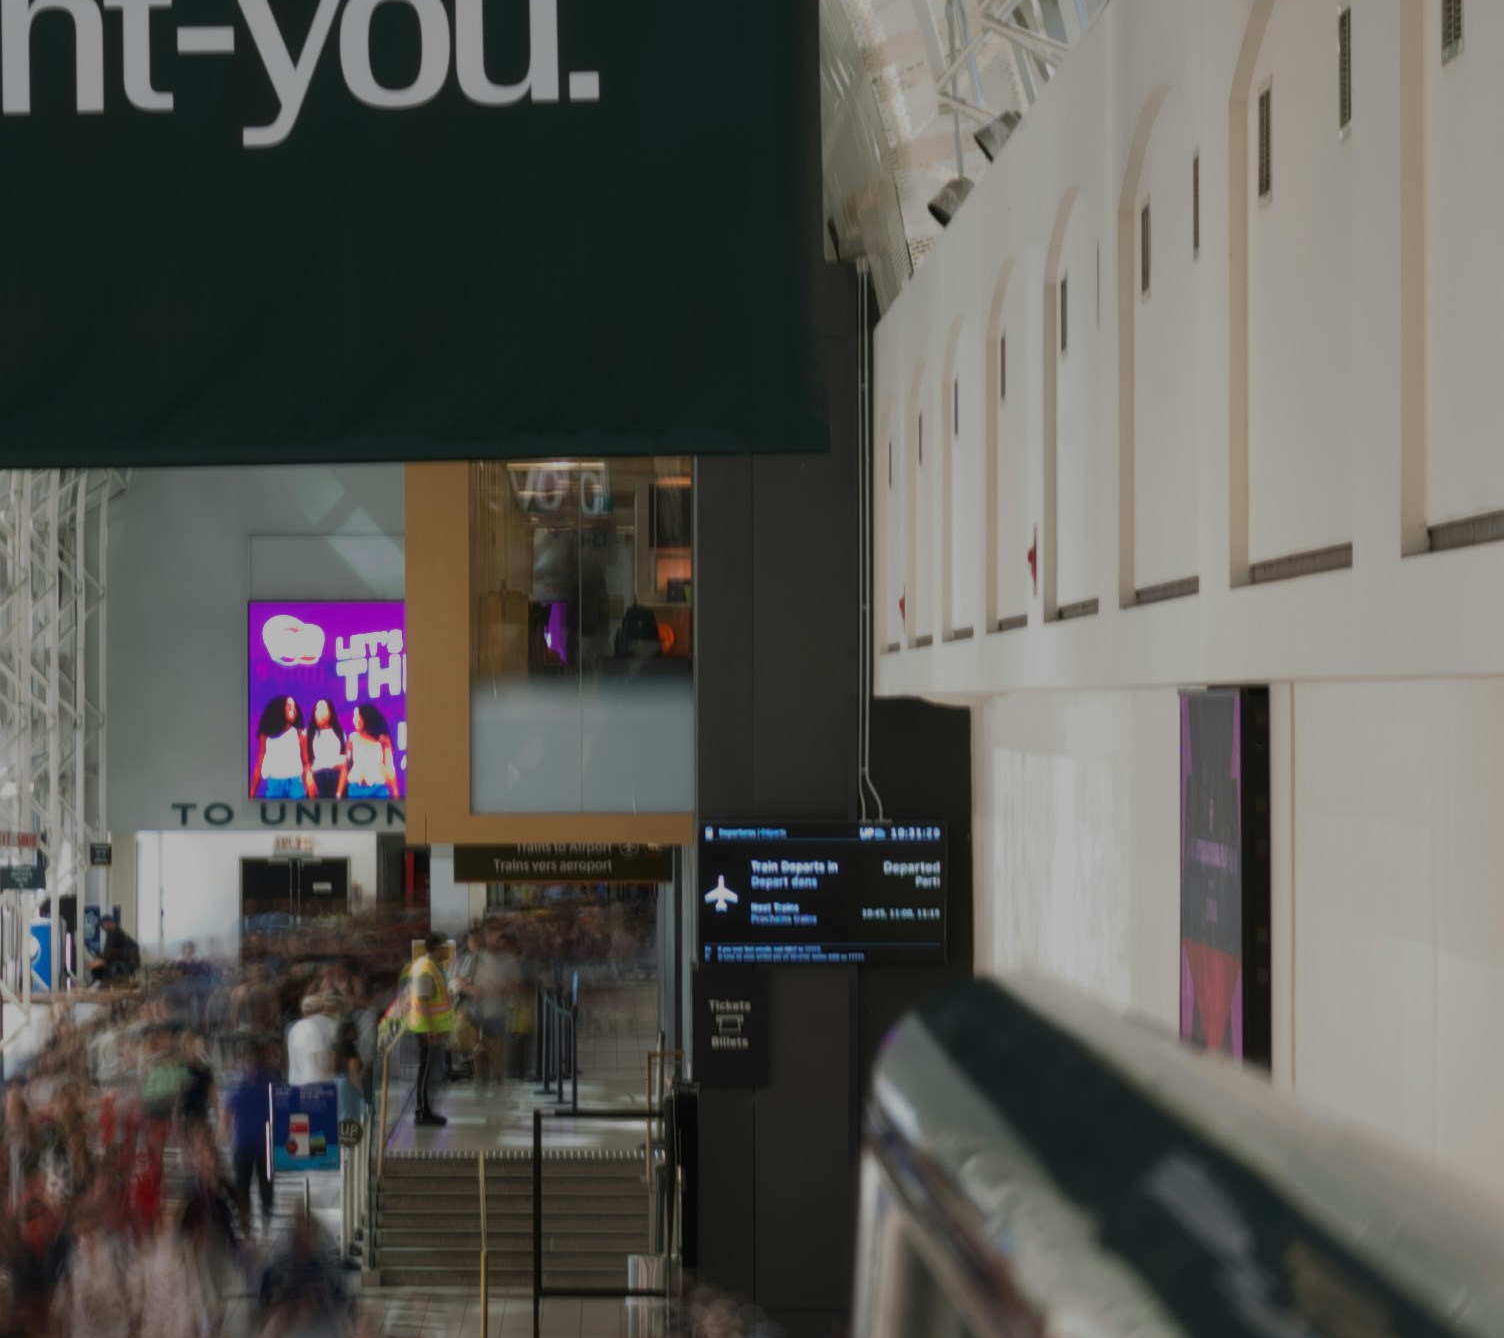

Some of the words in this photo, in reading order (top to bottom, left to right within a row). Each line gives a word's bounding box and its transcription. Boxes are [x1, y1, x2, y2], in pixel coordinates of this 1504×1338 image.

[172, 802, 234, 826] TO
[493, 858, 530, 873] Trains
[532, 860, 557, 873] vers
[751, 860, 778, 873] Train
[781, 860, 825, 876] Departs
[828, 860, 838, 873] in
[883, 860, 941, 877] Departed
[708, 999, 751, 1013] Tickets
[712, 1035, 749, 1050] Billets
